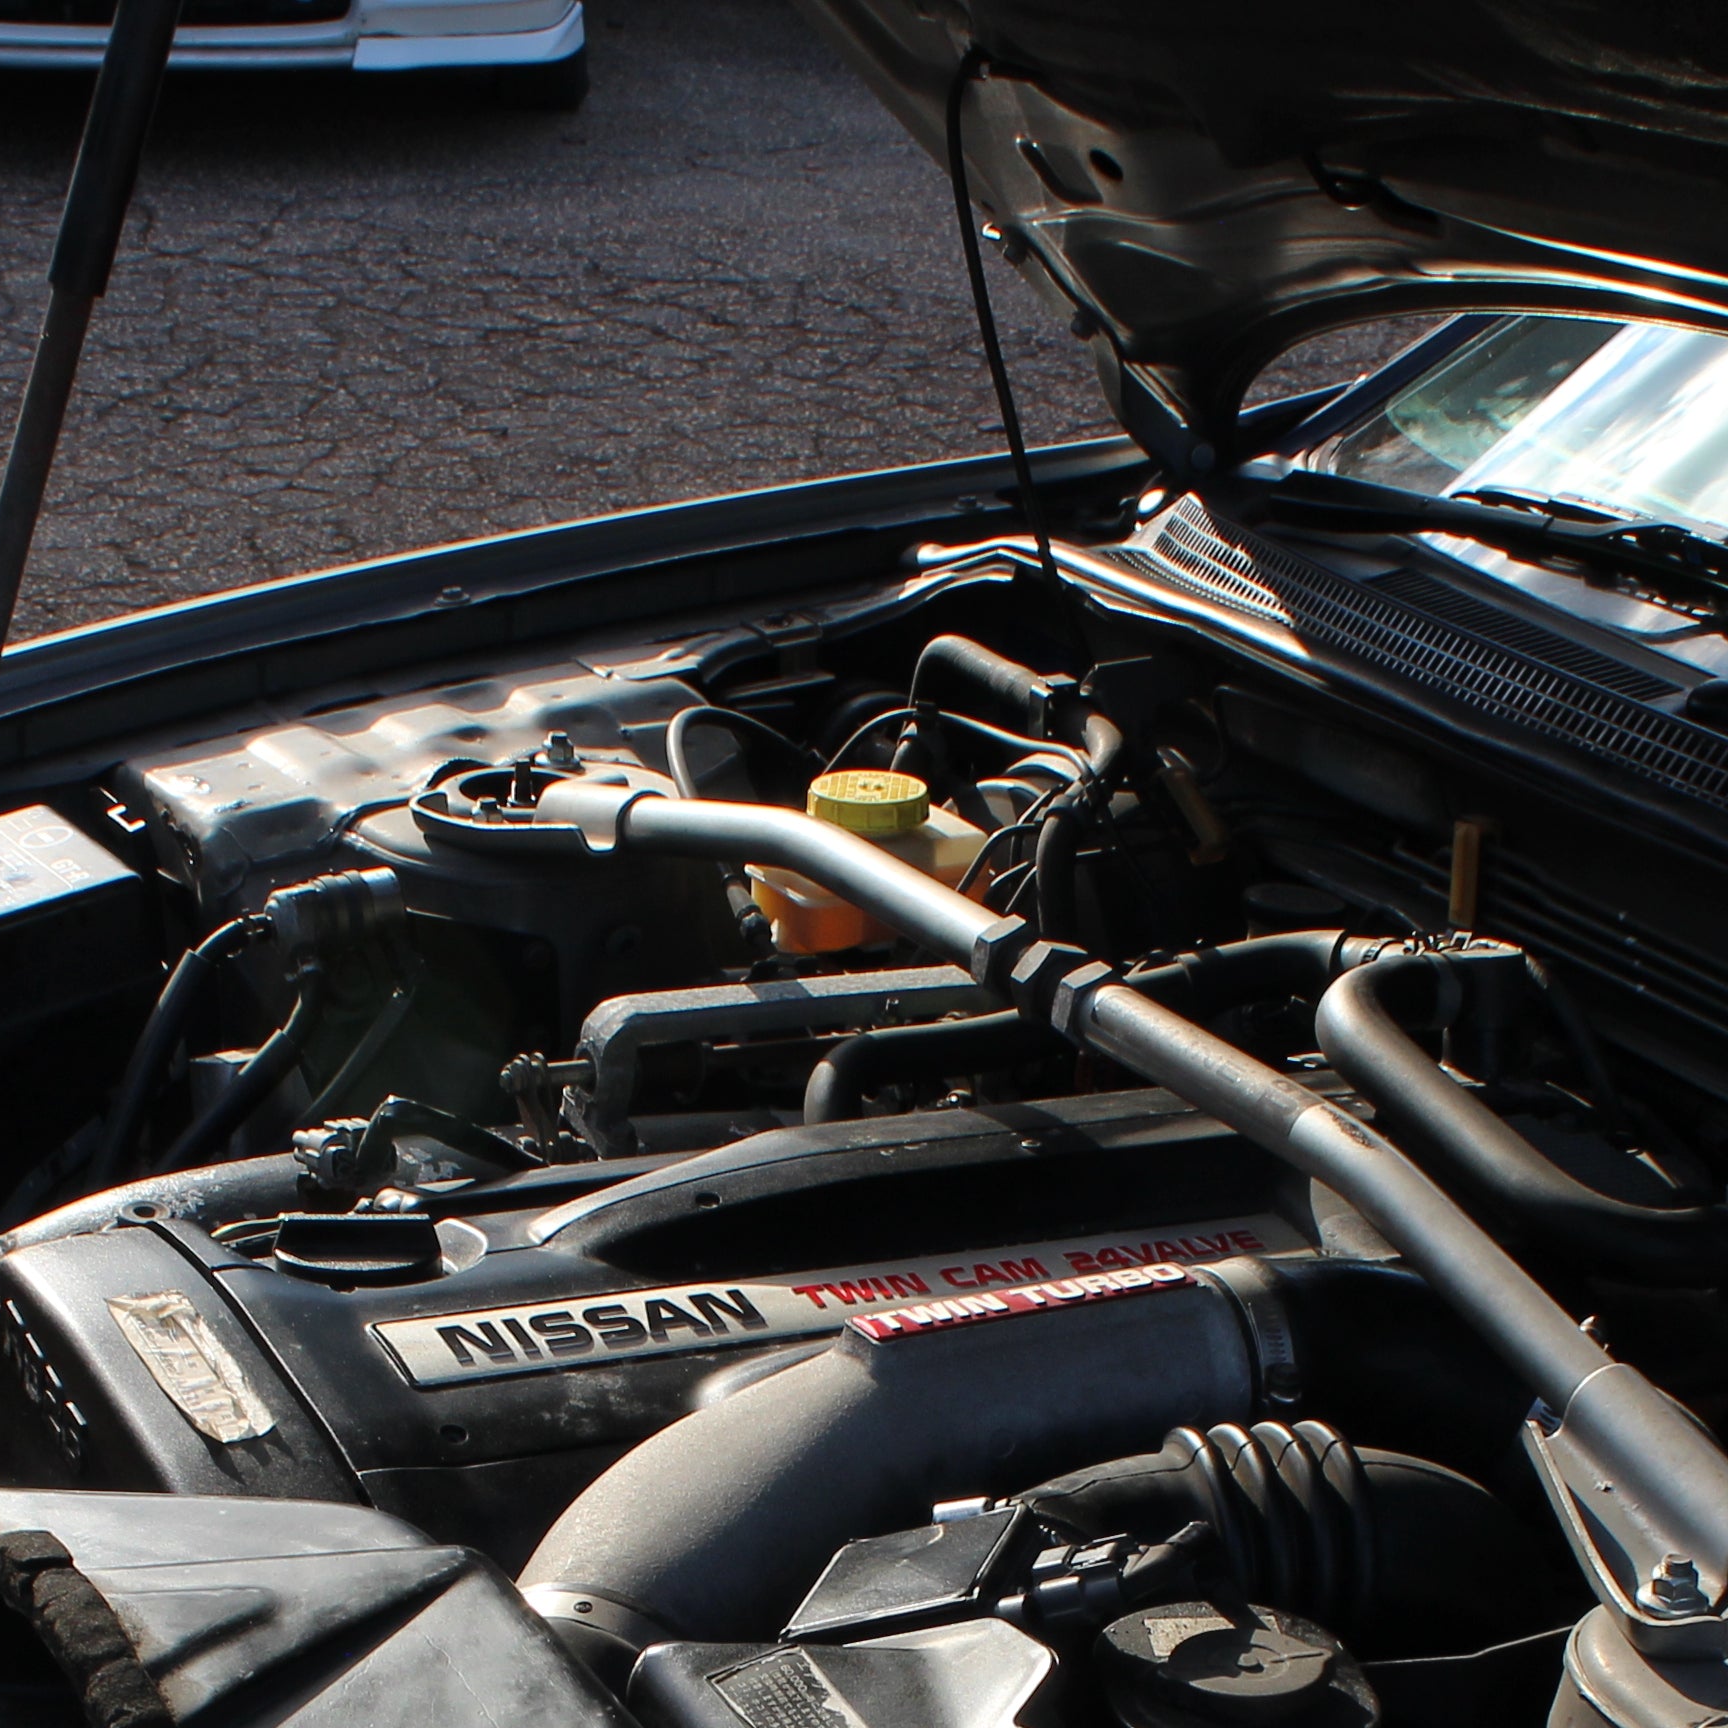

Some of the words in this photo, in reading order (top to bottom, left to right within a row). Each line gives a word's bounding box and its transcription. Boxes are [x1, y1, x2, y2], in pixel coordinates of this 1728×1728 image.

[791, 1271, 930, 1312] TWIN
[939, 1255, 1048, 1291] CAM
[1062, 1229, 1266, 1279] 24VALVE
[869, 1294, 1010, 1335] TWIN
[1015, 1261, 1189, 1310] TURBO
[432, 1287, 774, 1368] NISSAN
